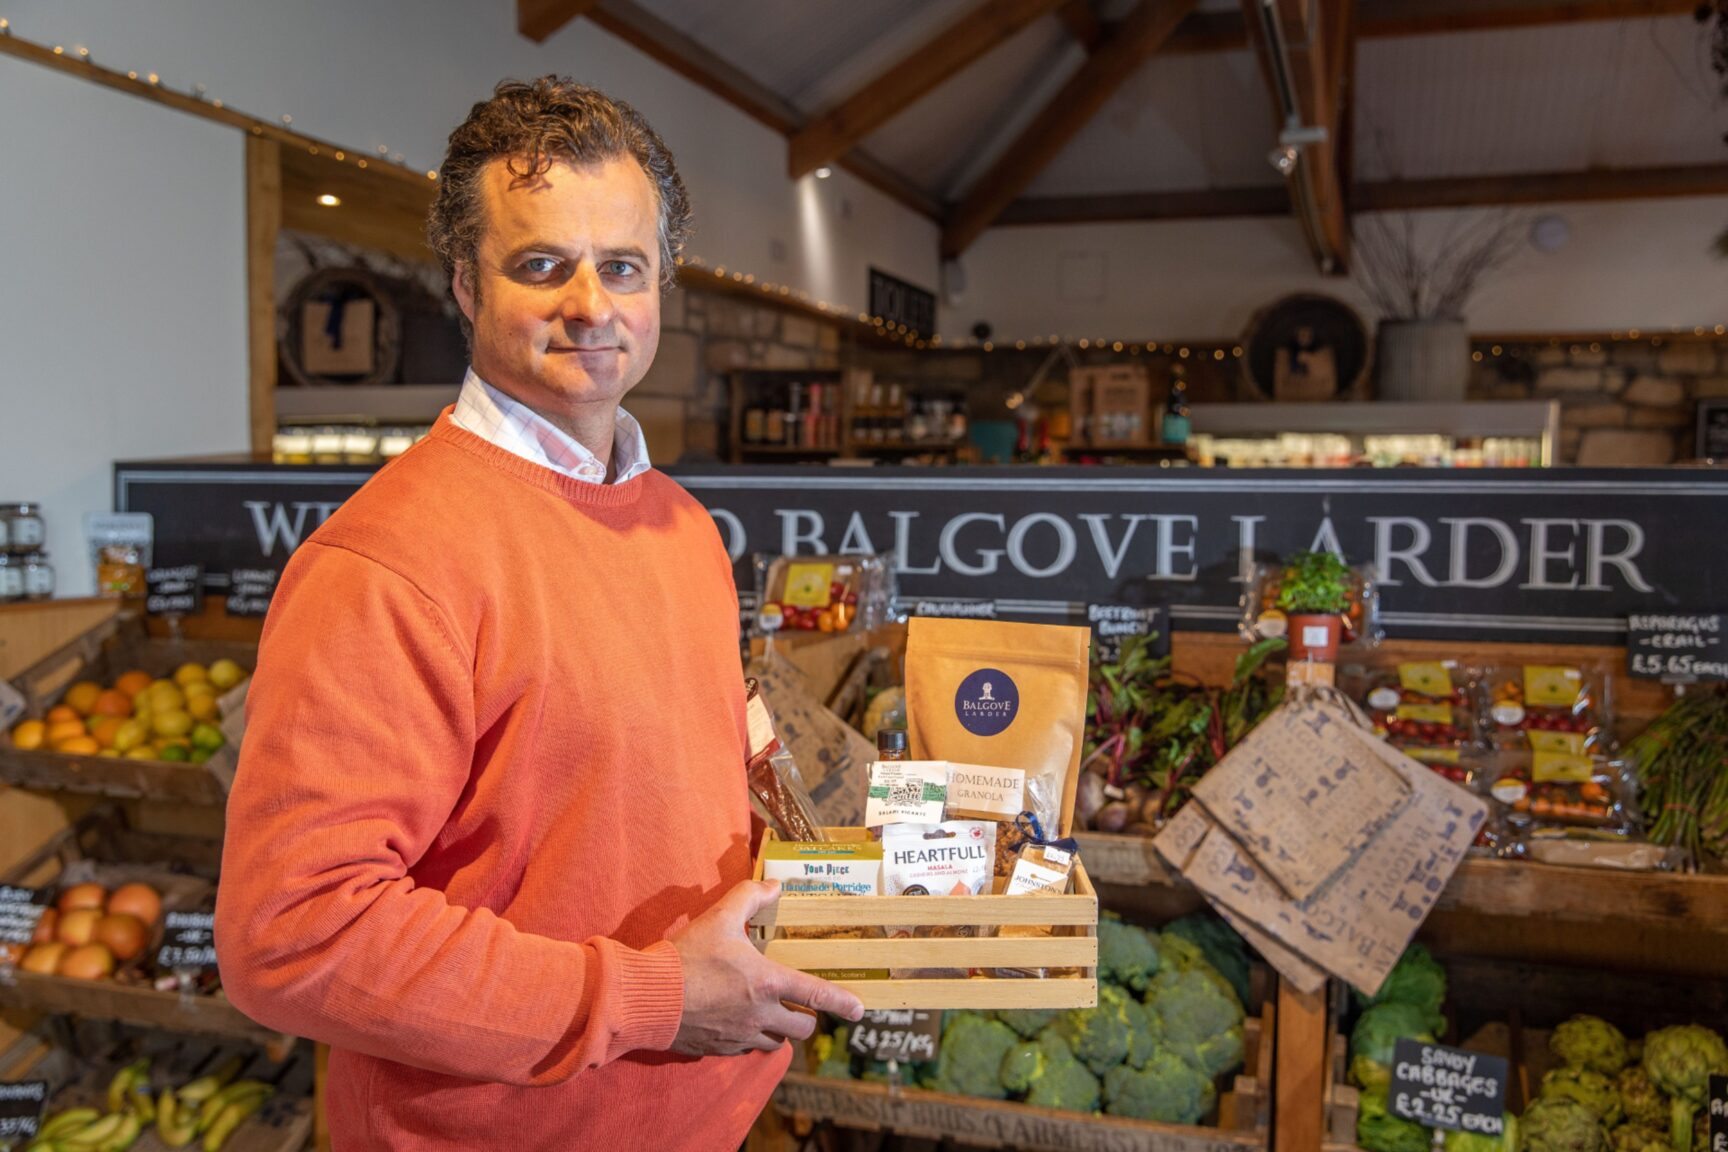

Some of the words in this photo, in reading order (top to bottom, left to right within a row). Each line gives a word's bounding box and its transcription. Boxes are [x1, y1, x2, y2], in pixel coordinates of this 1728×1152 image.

[774, 508, 1199, 580] BALGOVE
[1629, 615, 1719, 634] ASPARAGUS
[963, 700, 1011, 711] BALGOVE
[957, 789, 1004, 802] GRANOLA
[894, 846, 985, 865] HEARTFULL
[1421, 1046, 1477, 1076] SAVOY
[1396, 1061, 1498, 1098] CABBAGES
